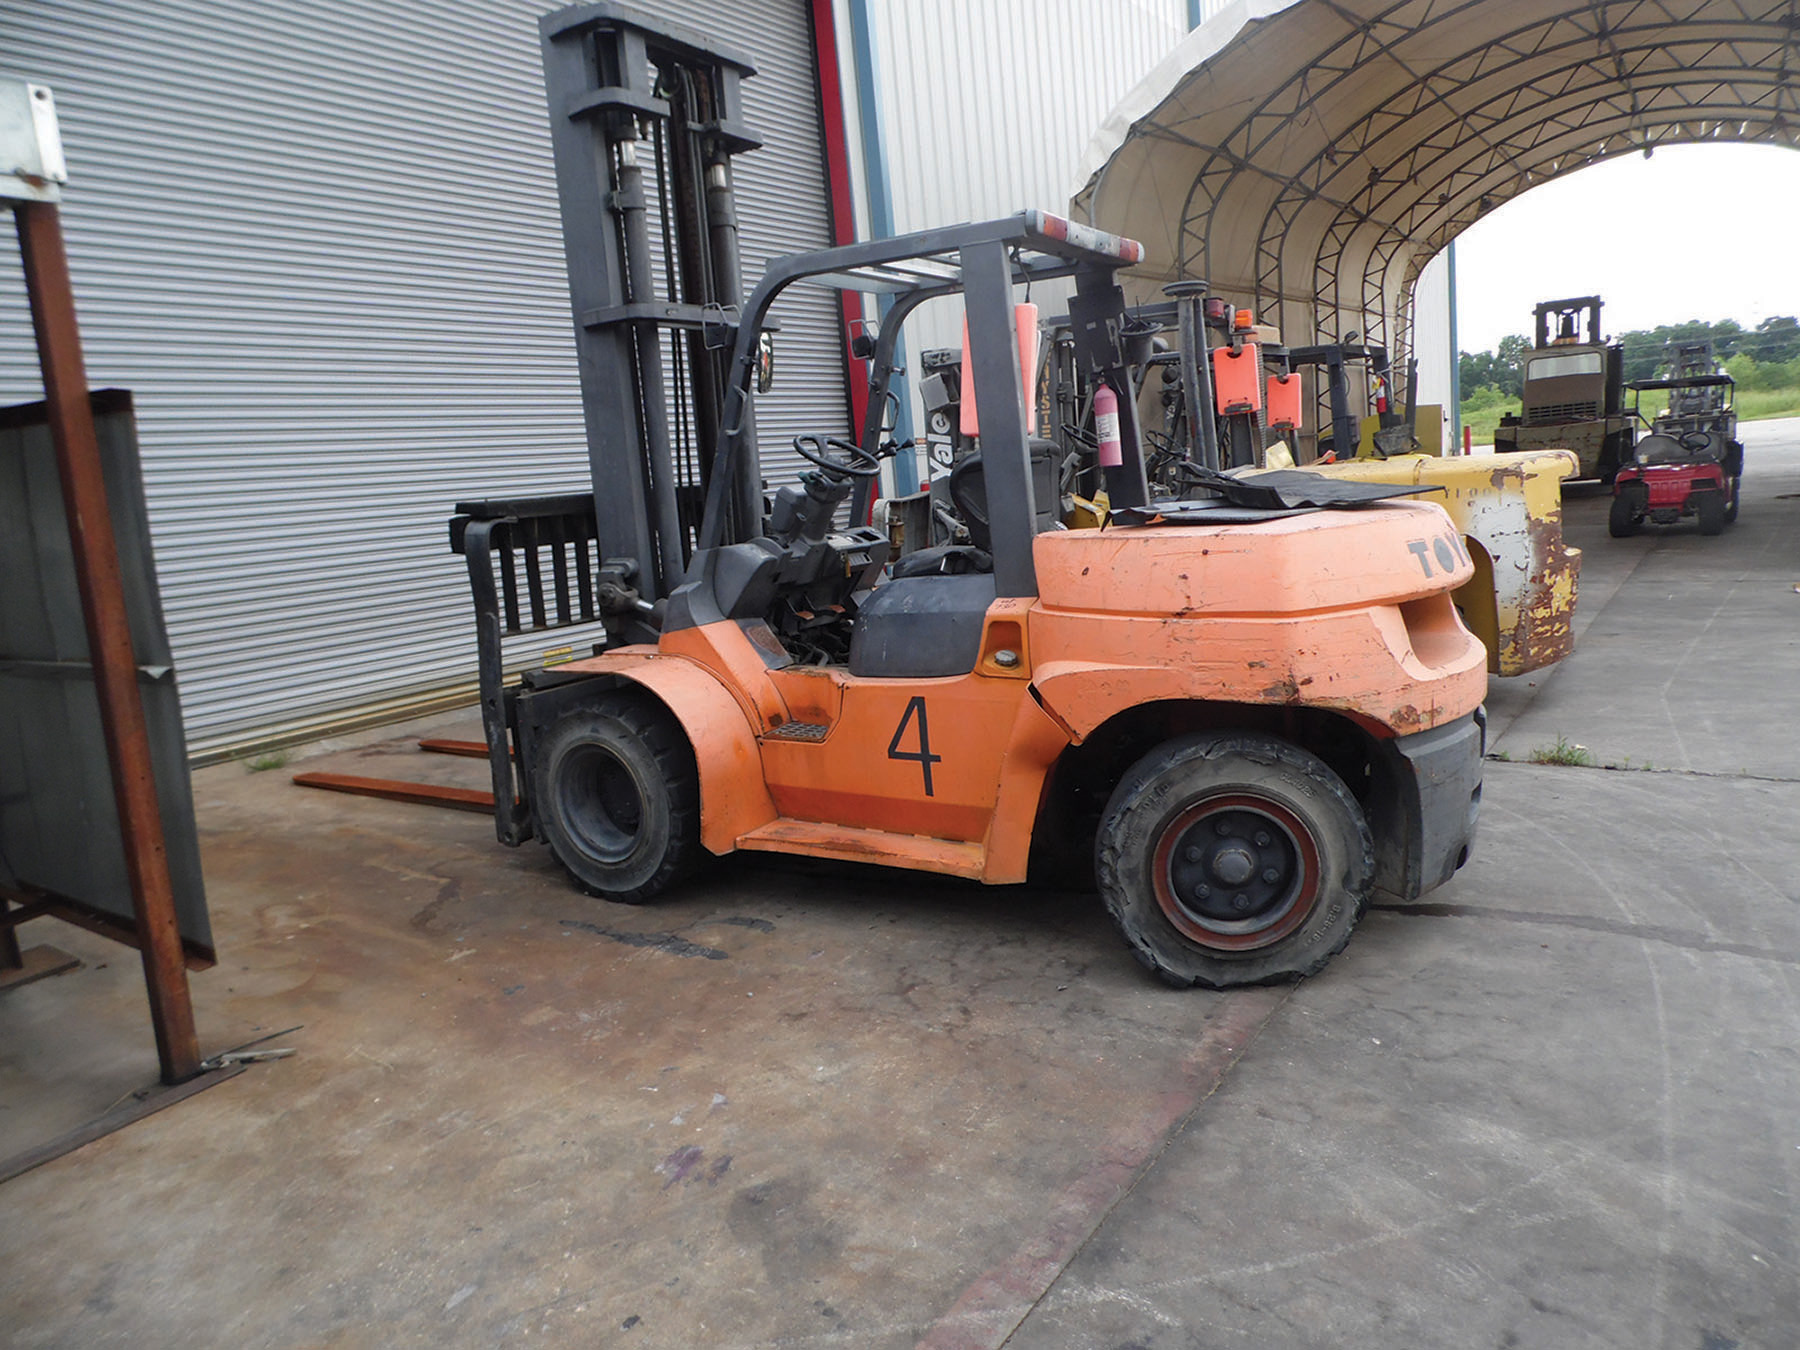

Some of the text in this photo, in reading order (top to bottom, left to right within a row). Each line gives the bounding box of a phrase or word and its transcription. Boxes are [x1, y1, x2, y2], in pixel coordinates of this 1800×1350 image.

[929, 412, 954, 482] Yale
[1407, 531, 1471, 578] TOY
[888, 696, 941, 797] 4
